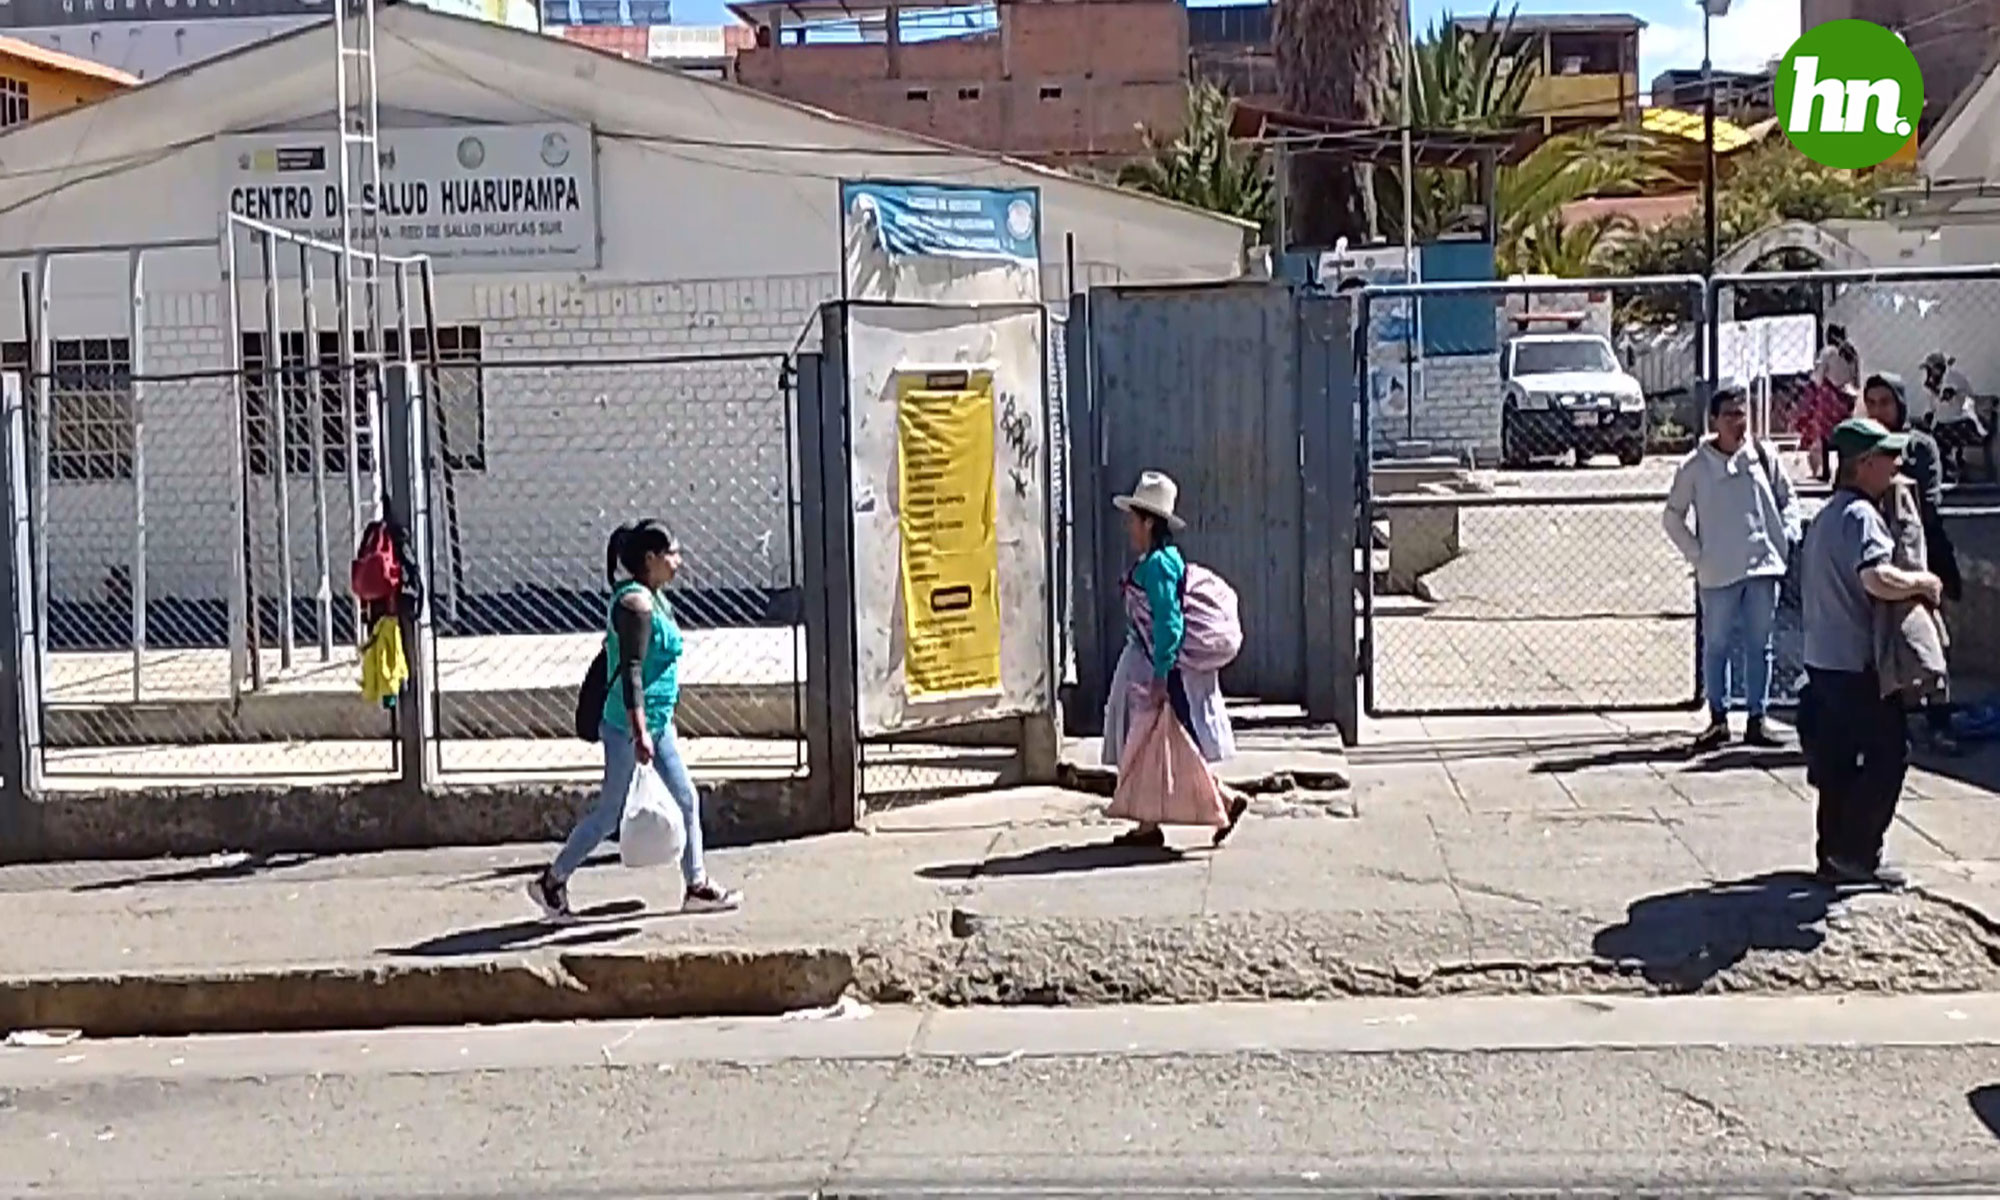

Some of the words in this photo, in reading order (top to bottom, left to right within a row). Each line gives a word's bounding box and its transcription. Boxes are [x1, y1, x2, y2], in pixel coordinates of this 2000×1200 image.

[231, 186, 312, 219] CENTRO
[363, 182, 428, 216] SALUD
[441, 176, 579, 215] HUARUPAMPA
